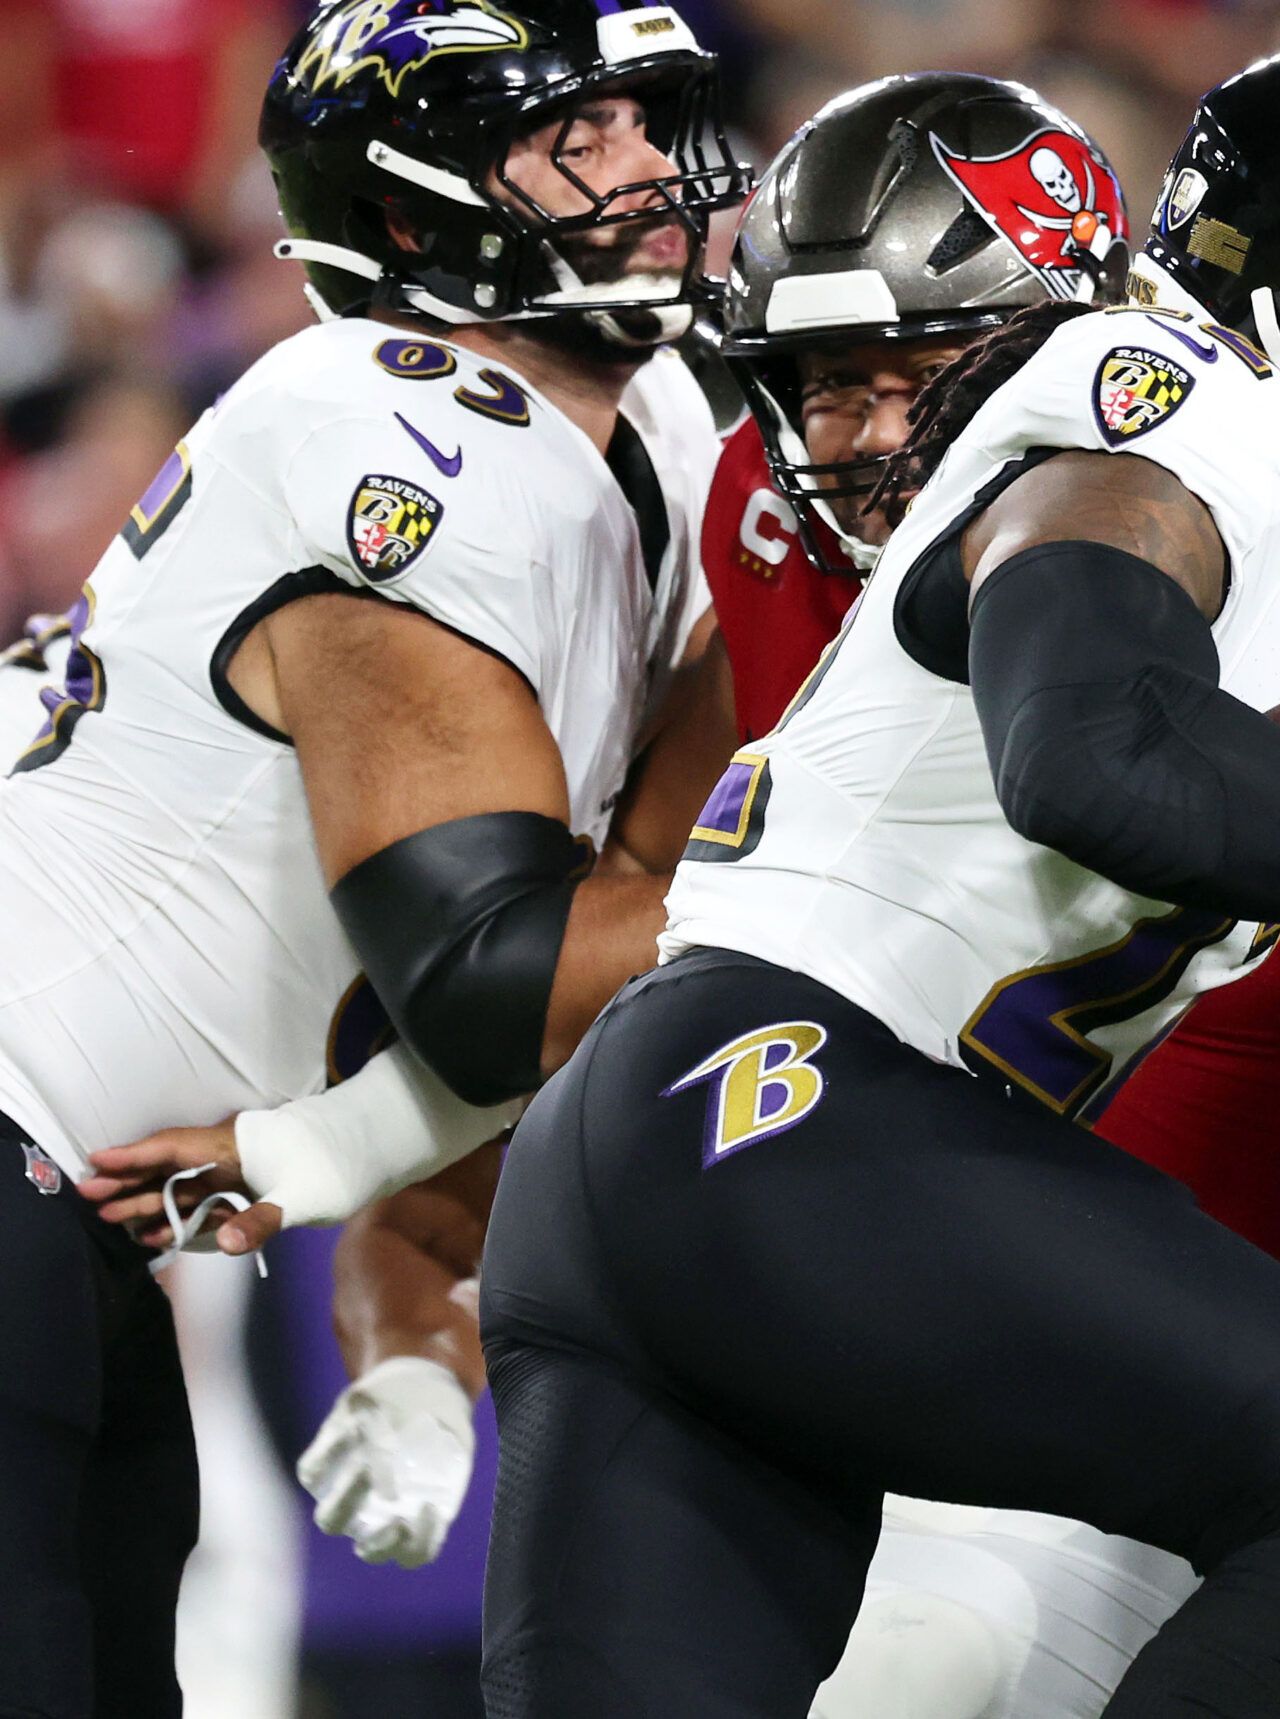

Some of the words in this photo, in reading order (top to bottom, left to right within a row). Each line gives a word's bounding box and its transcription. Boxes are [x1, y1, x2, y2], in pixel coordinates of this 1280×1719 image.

[1115, 349, 1188, 384] RAVENS
[367, 477, 437, 513] RAVENS
[740, 488, 798, 565] C
[660, 1020, 830, 1168] B
